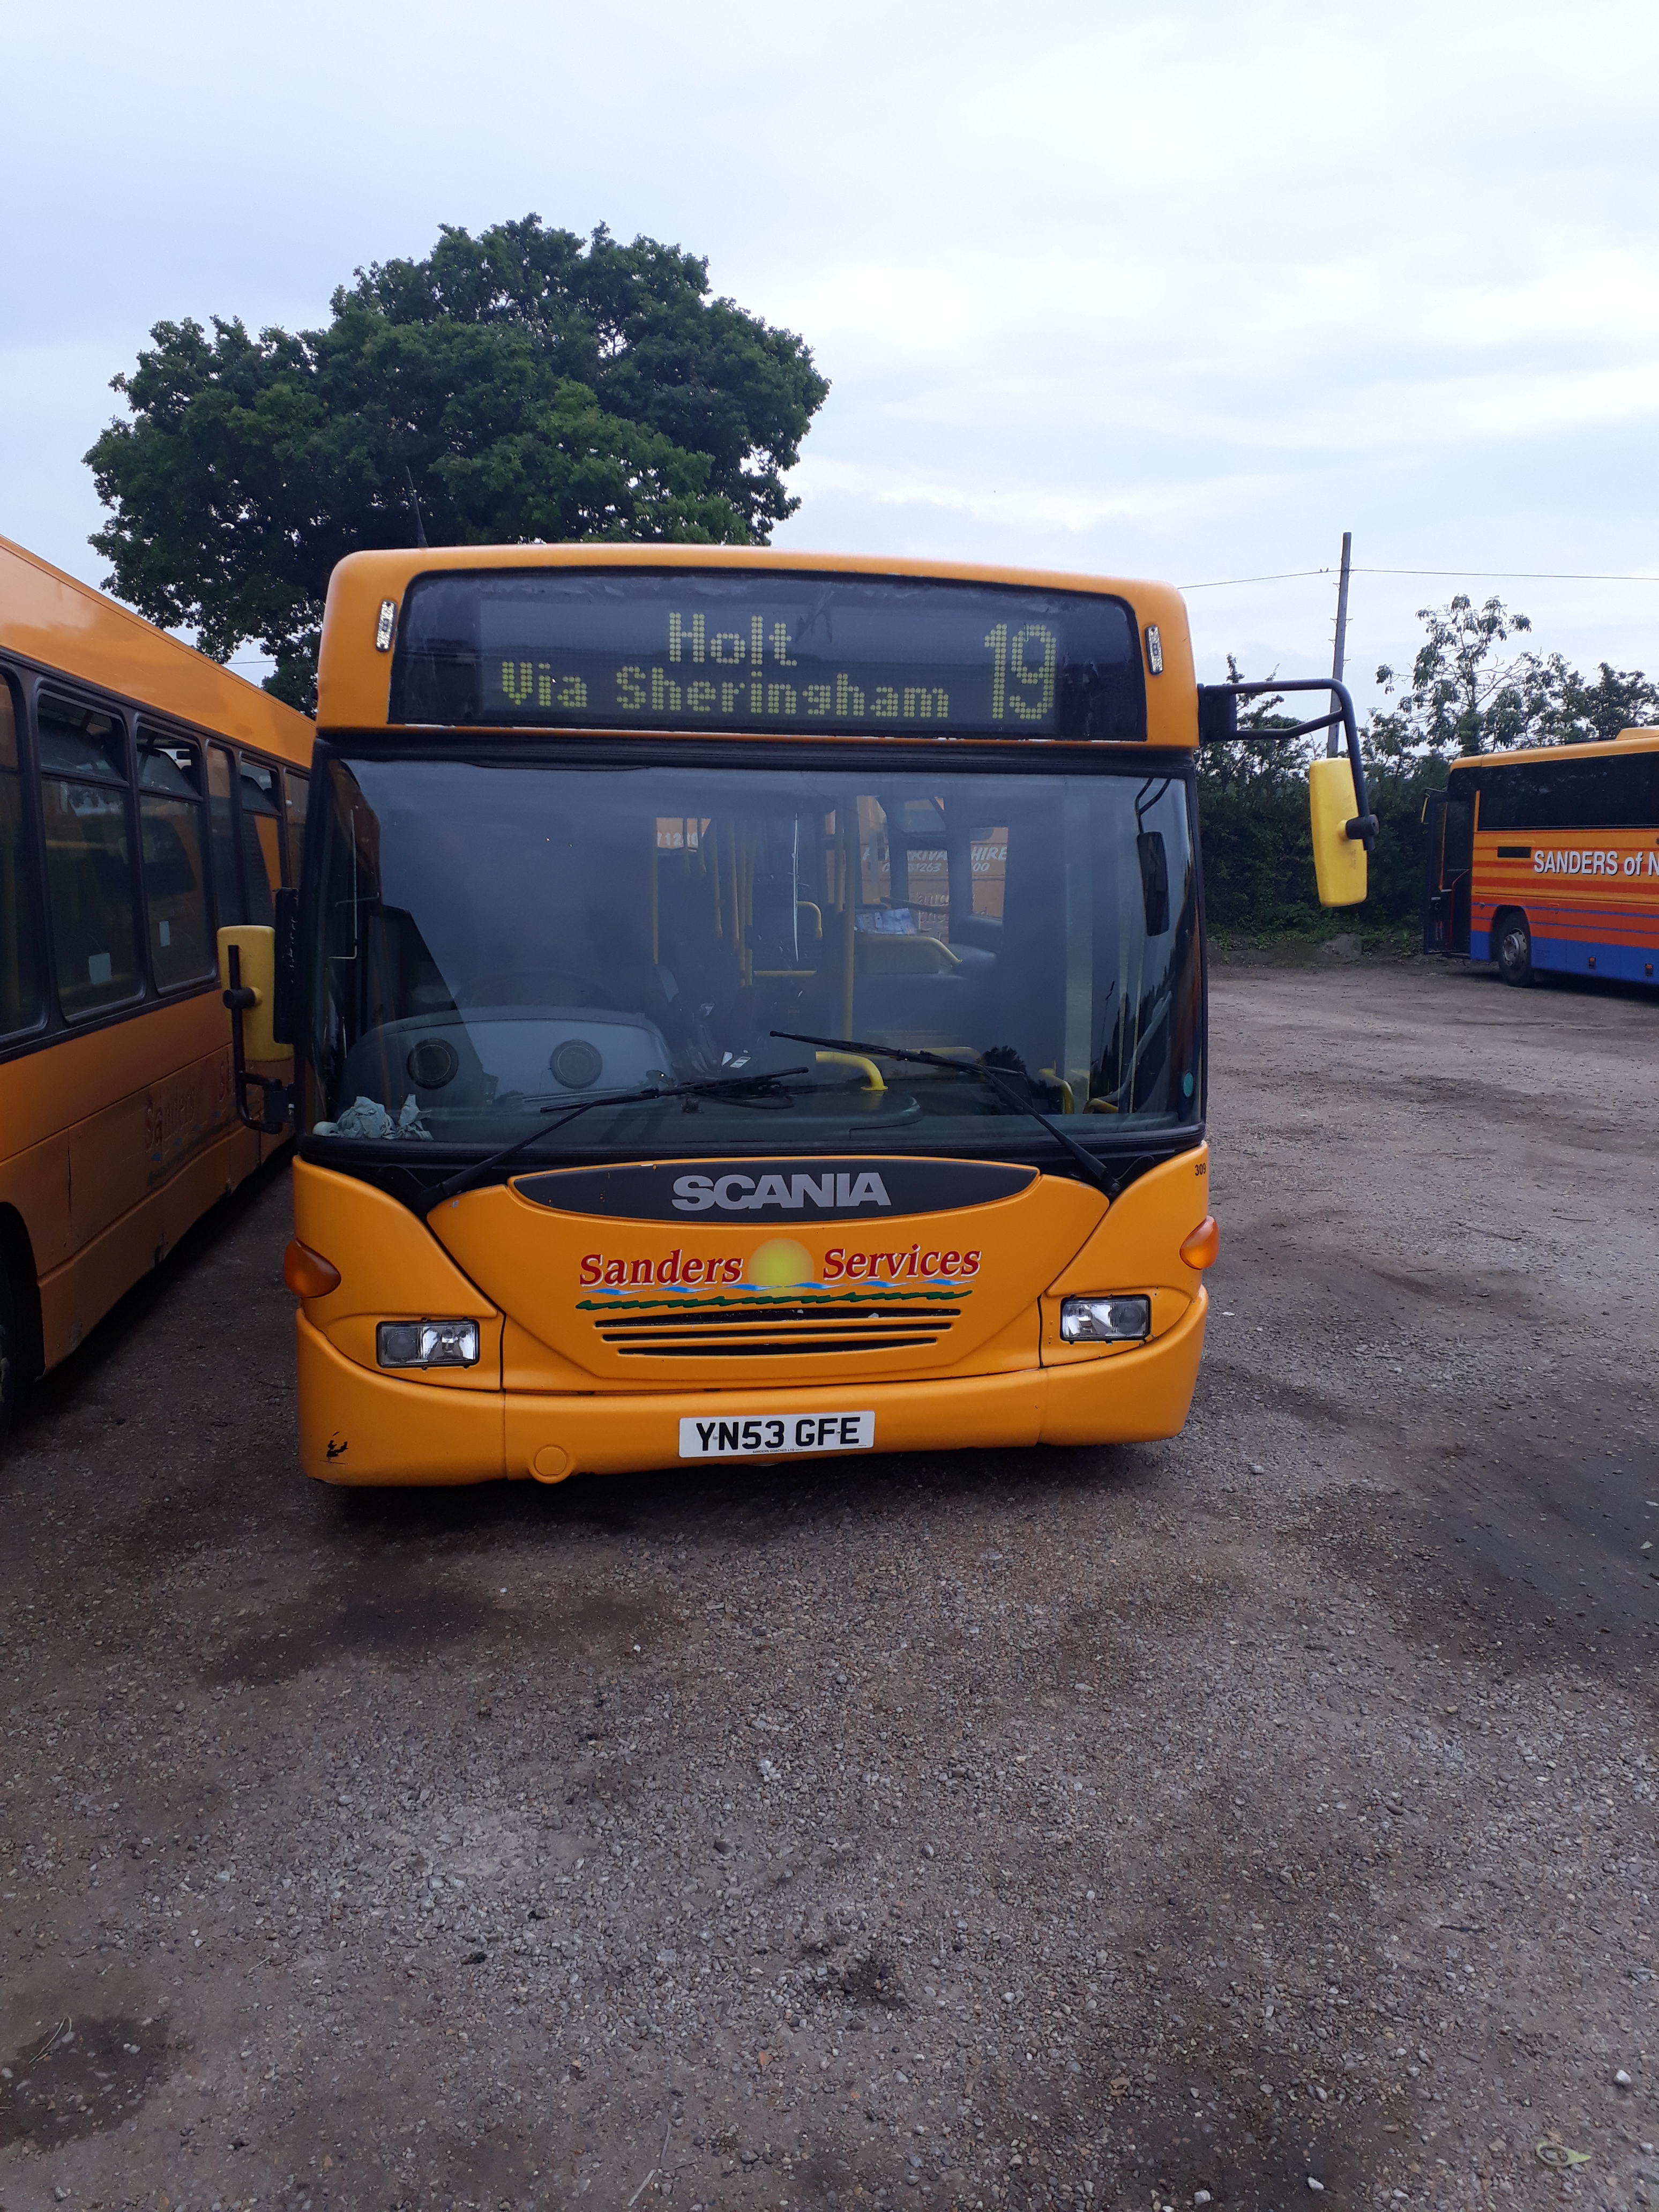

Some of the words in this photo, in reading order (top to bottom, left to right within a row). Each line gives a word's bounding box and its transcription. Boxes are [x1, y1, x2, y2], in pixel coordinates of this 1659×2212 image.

[669, 612, 797, 666] Holt
[501, 661, 588, 708] Via
[616, 666, 950, 719] Sheringham
[984, 623, 1057, 721] 19
[971, 847, 1007, 861] HIRE
[1534, 850, 1618, 876] SANDERS
[1624, 852, 1643, 876] of
[671, 1172, 891, 1210] SCANIA
[580, 1249, 743, 1286] Sanders
[824, 1244, 982, 1280] Services
[696, 1419, 786, 1451] YN53
[796, 1417, 860, 1446] GFE
